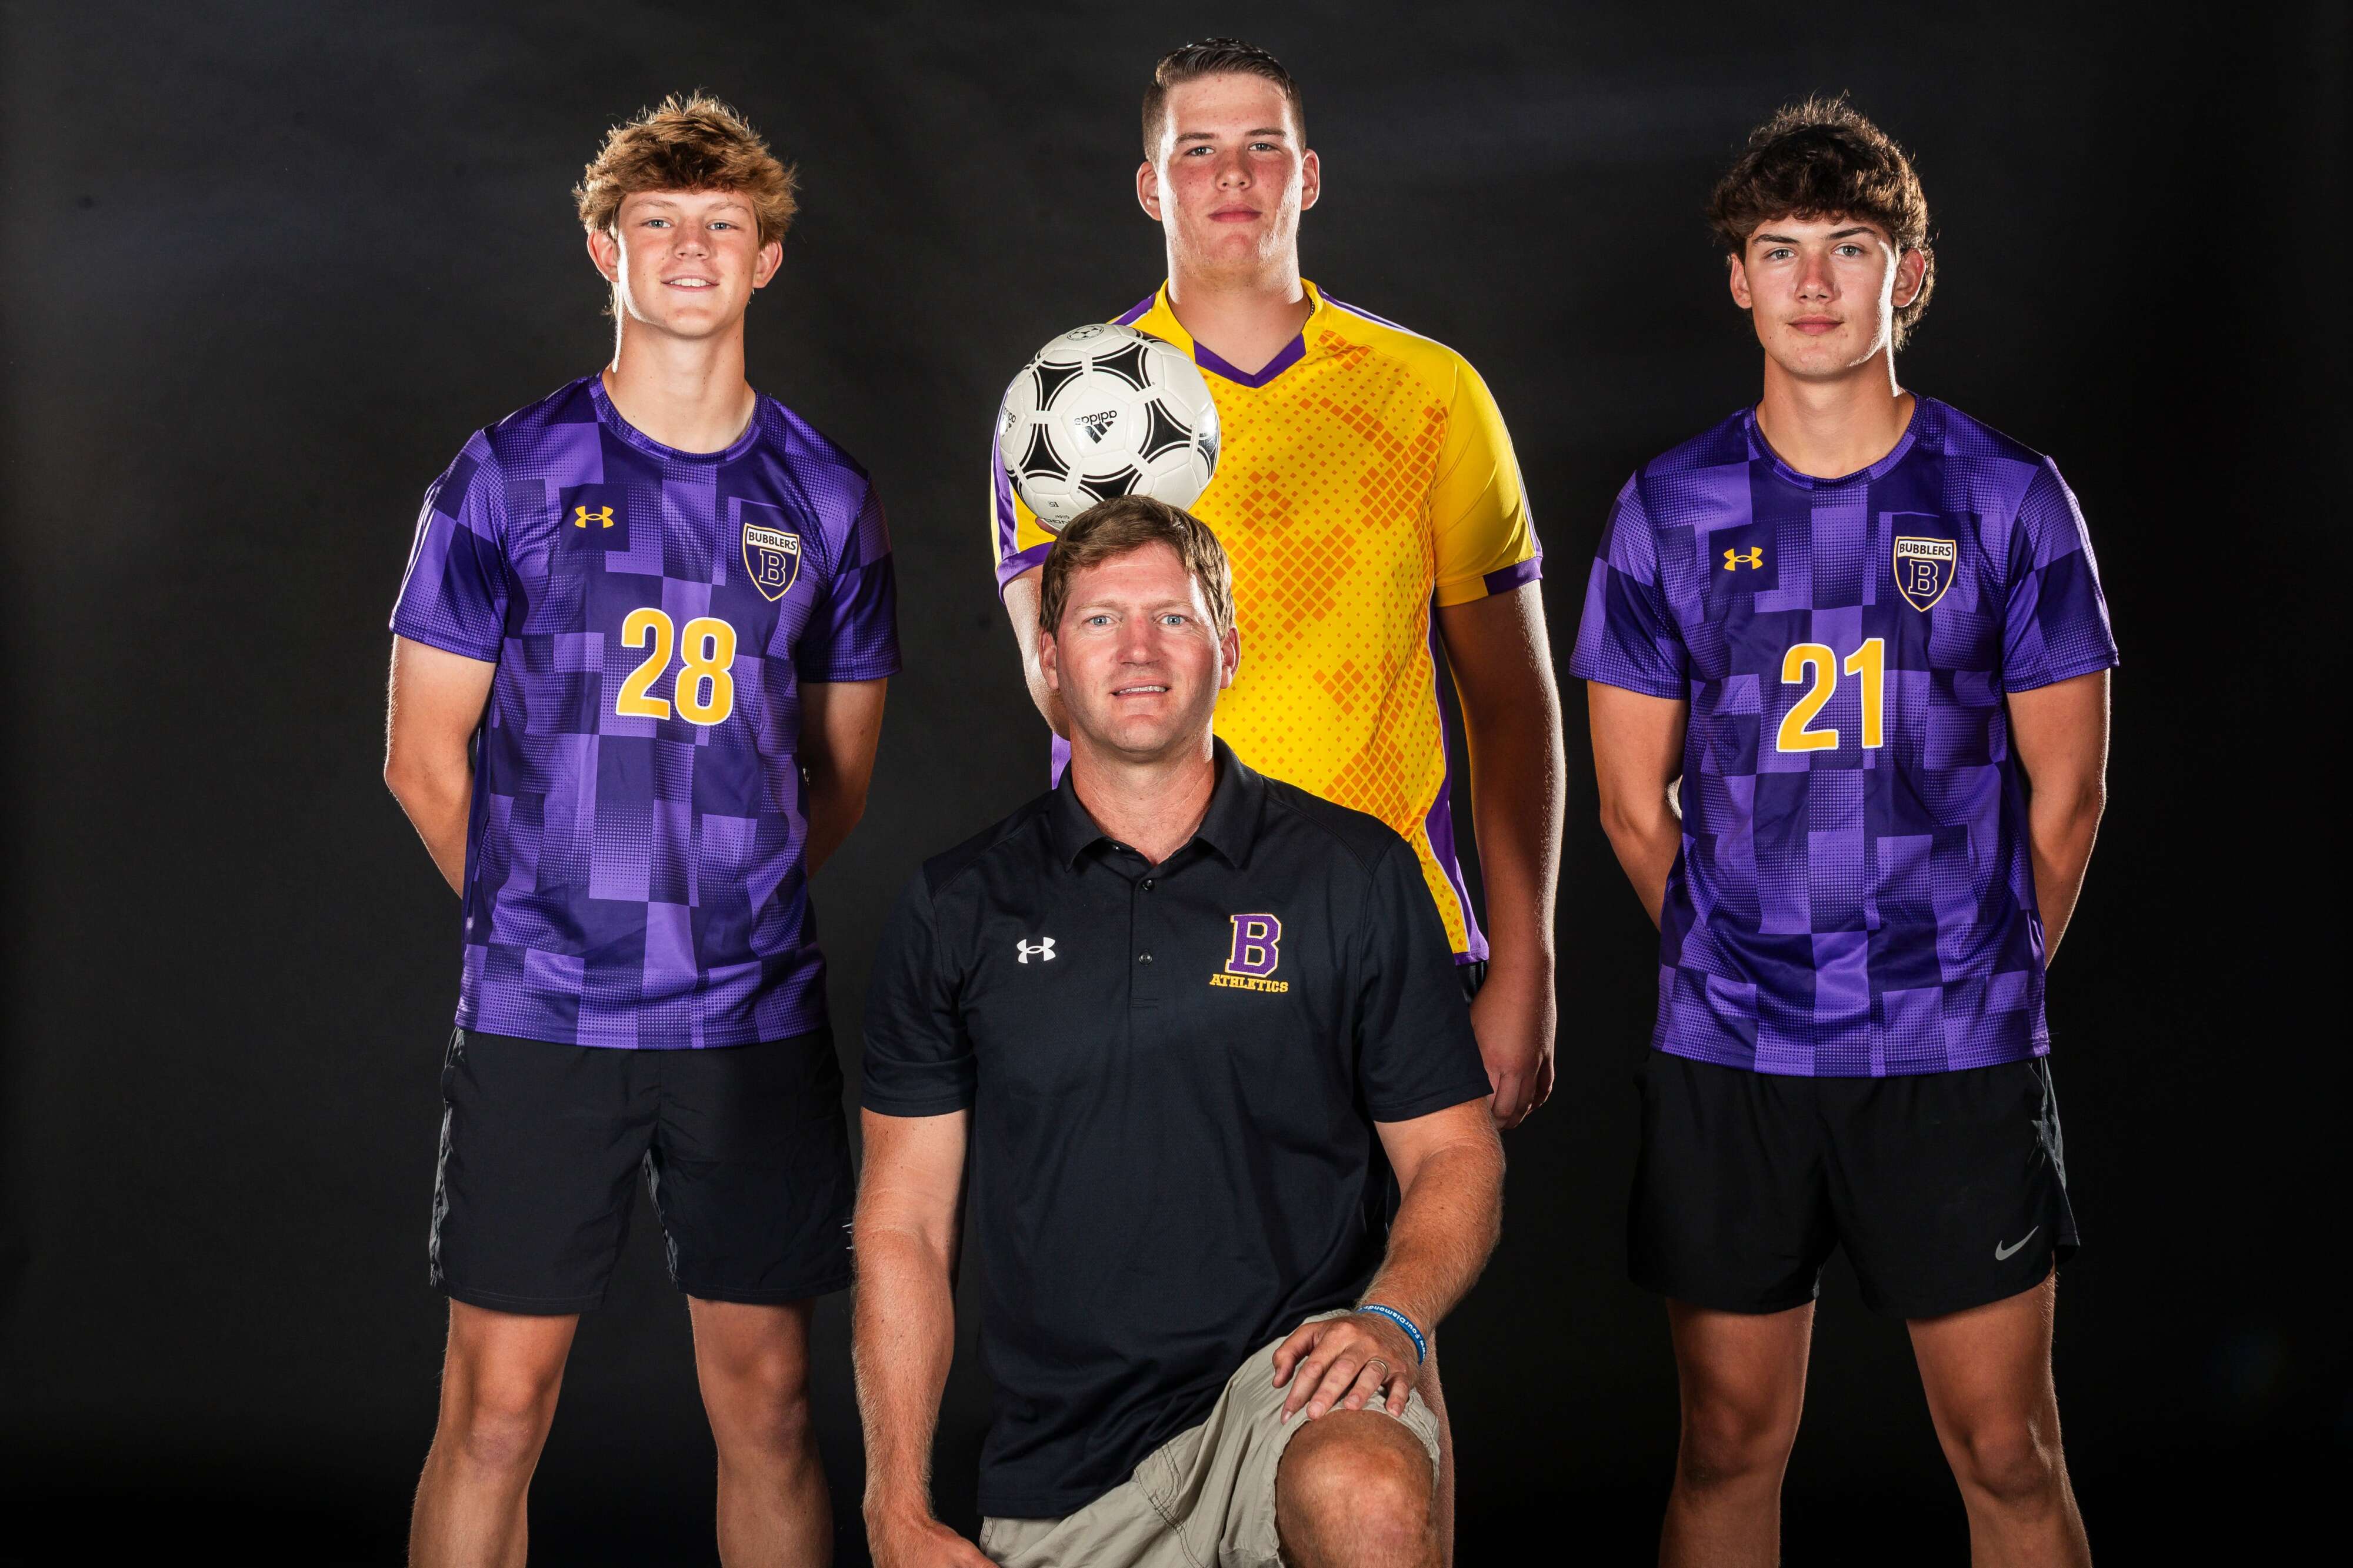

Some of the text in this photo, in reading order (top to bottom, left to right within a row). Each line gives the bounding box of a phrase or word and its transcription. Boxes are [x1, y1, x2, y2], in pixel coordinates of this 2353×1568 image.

[1074, 410, 1118, 426] adidas
[748, 531, 797, 551] BUBBLERS
[1898, 542, 1952, 556] BUBBLERS
[758, 548, 786, 587] B
[1908, 559, 1939, 597] B
[615, 607, 738, 726] 28
[1776, 638, 1885, 753] 21
[1224, 913, 1282, 978] B
[1209, 973, 1289, 993] ATHLETICS
